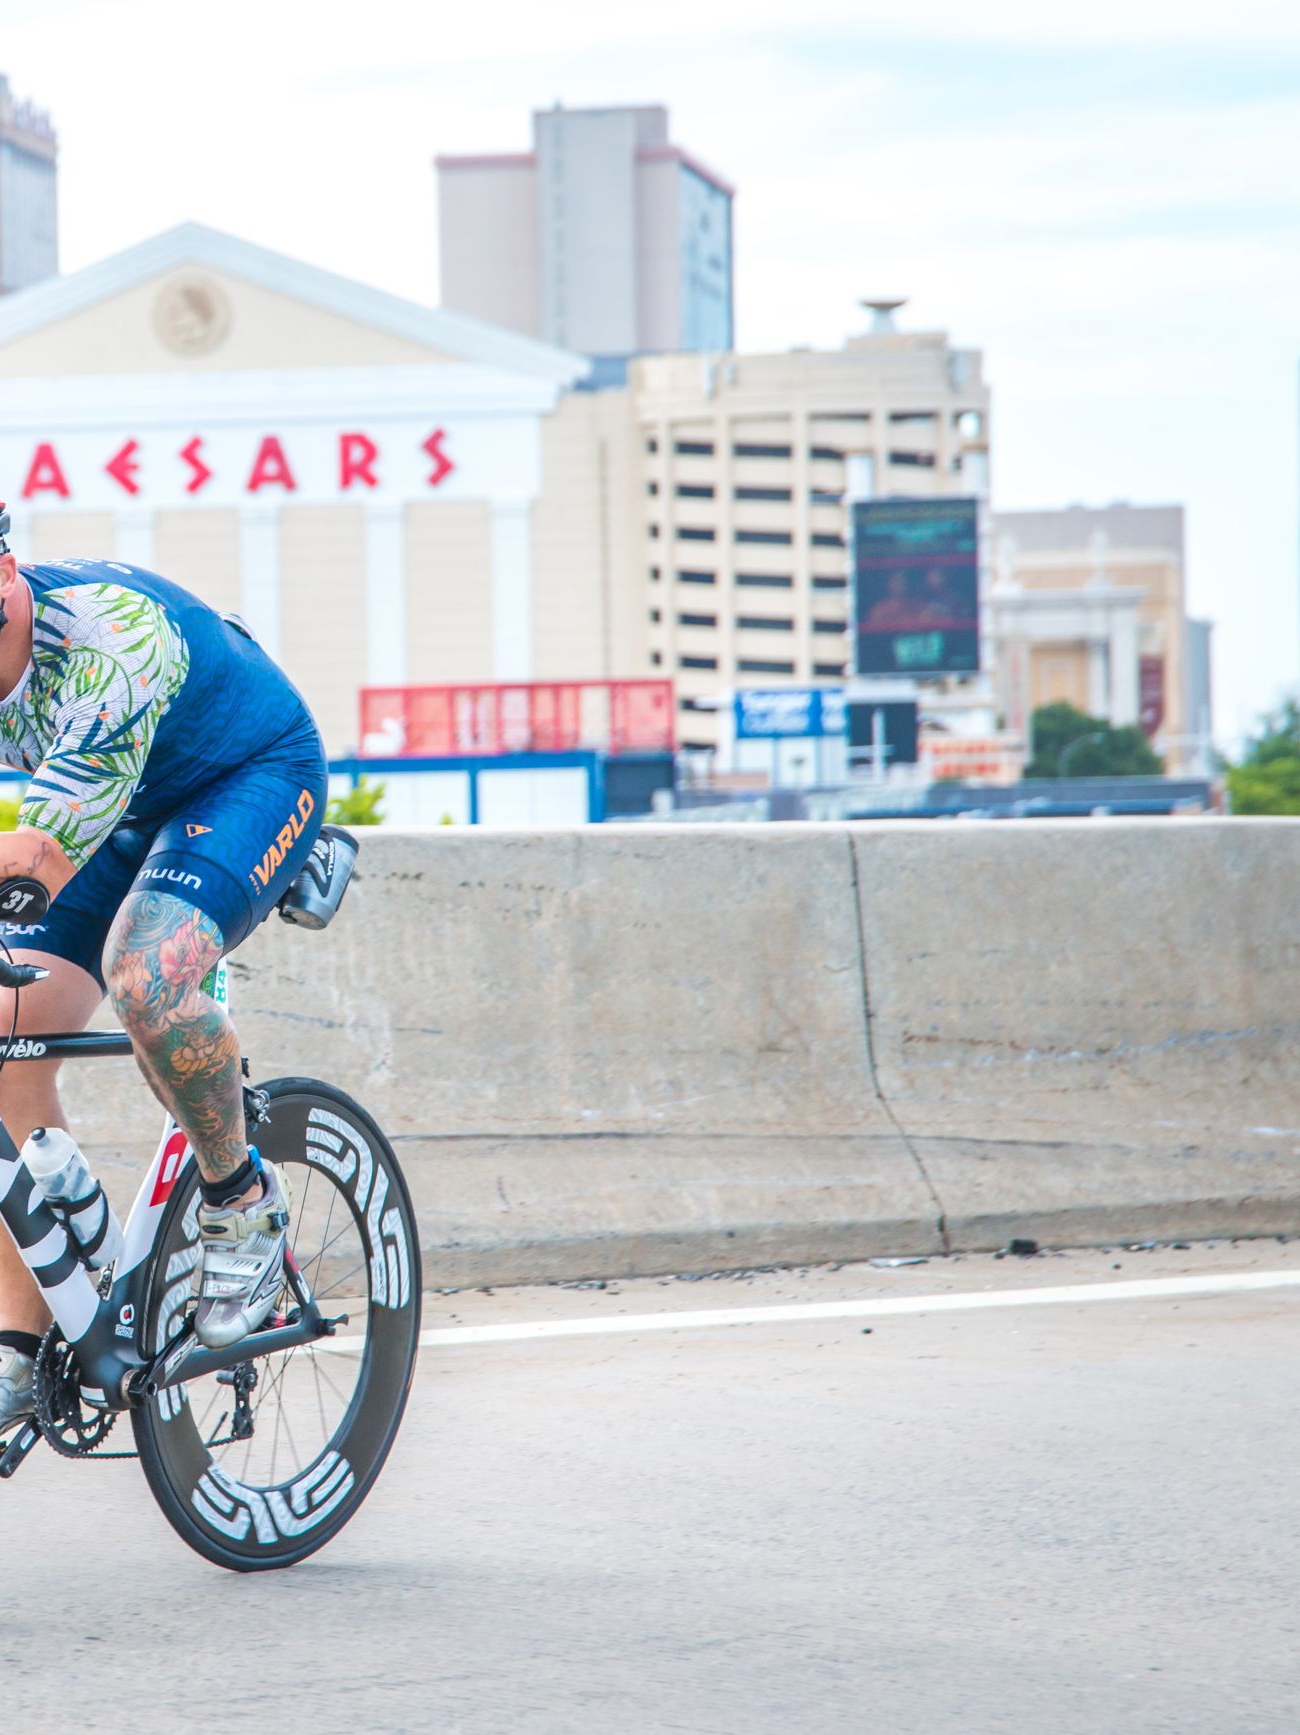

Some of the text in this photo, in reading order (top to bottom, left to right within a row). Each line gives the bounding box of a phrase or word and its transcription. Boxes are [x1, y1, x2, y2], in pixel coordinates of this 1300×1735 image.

[253, 789, 314, 887] VARLO
[137, 866, 203, 891] nuun
[1, 890, 35, 915] 3T
